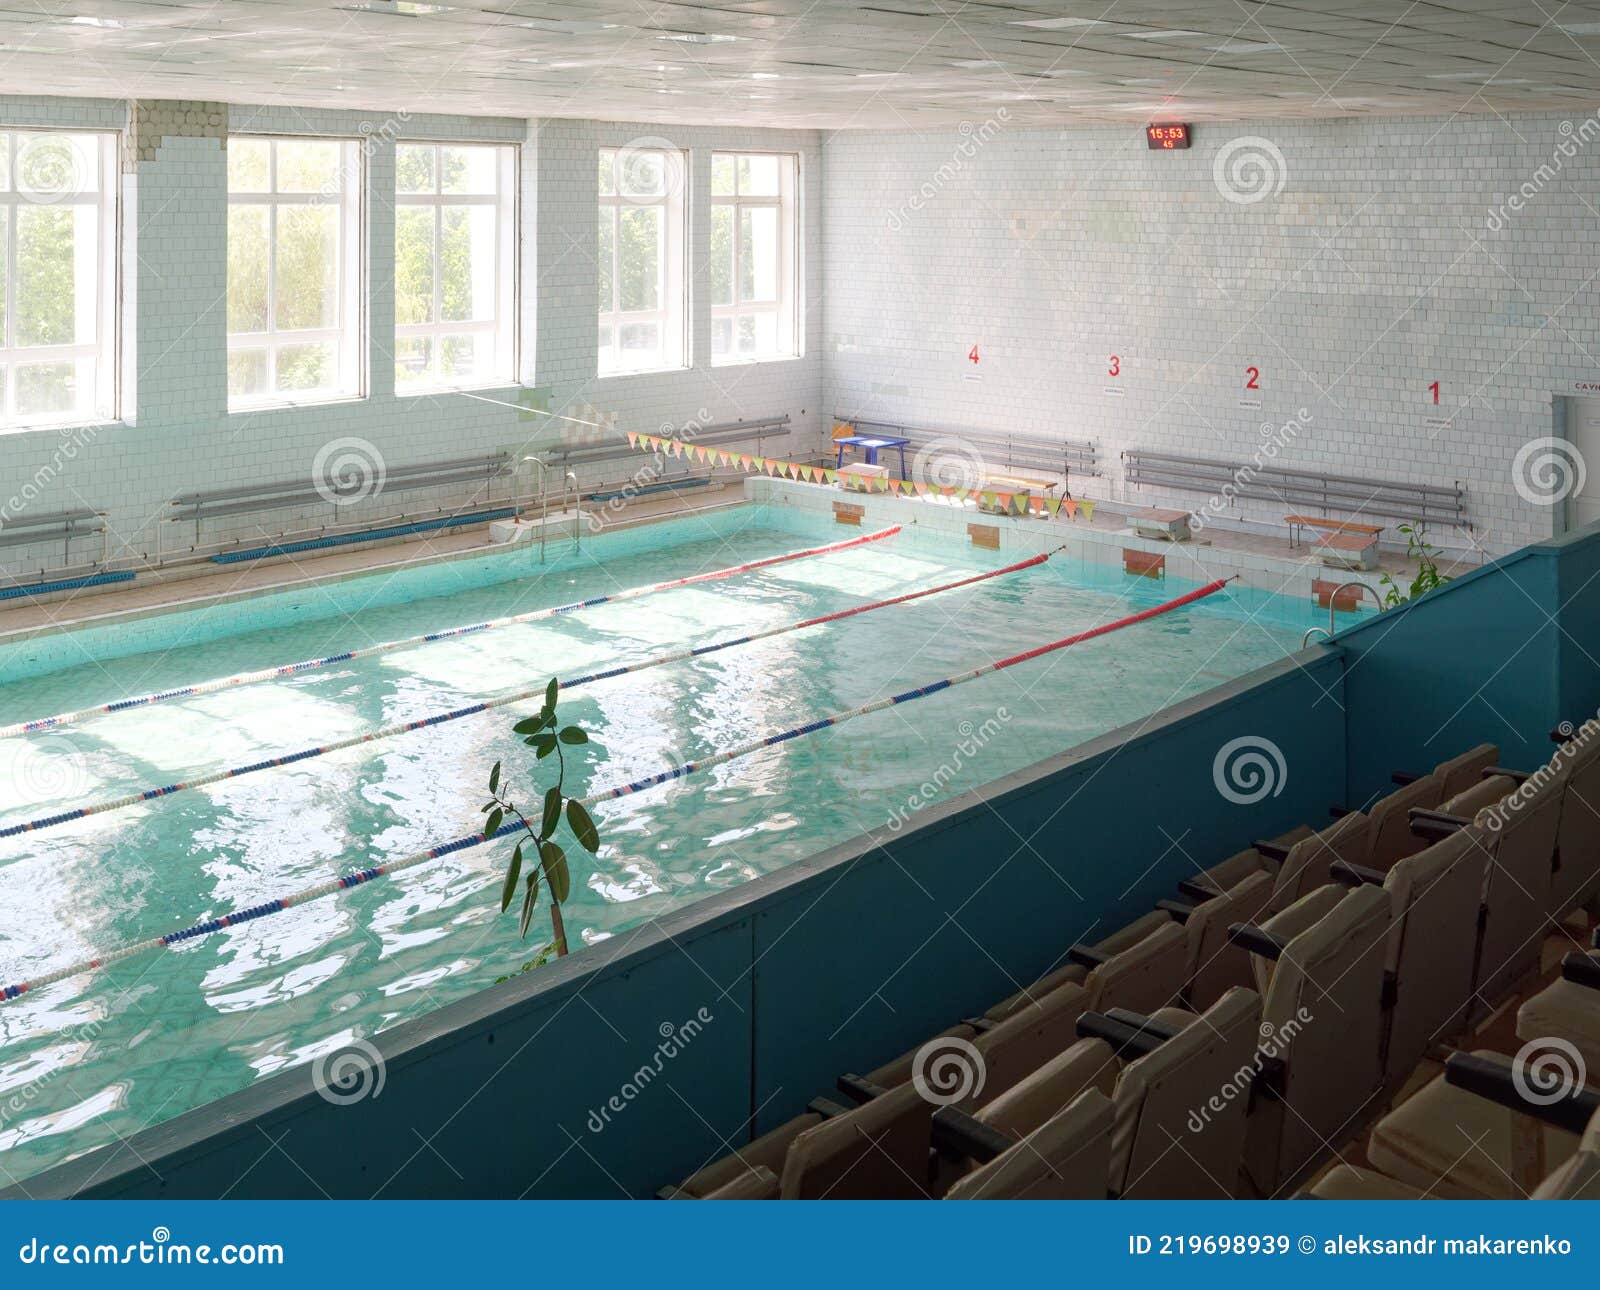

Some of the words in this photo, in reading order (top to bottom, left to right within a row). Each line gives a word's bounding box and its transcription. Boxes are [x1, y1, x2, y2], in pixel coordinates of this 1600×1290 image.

[1150, 128, 1183, 139] 15:53
[1163, 140, 1174, 148] 45
[968, 344, 980, 365] 4
[1108, 355, 1120, 377] 3
[1246, 367, 1259, 389] 2
[1428, 380, 1439, 406] 1
